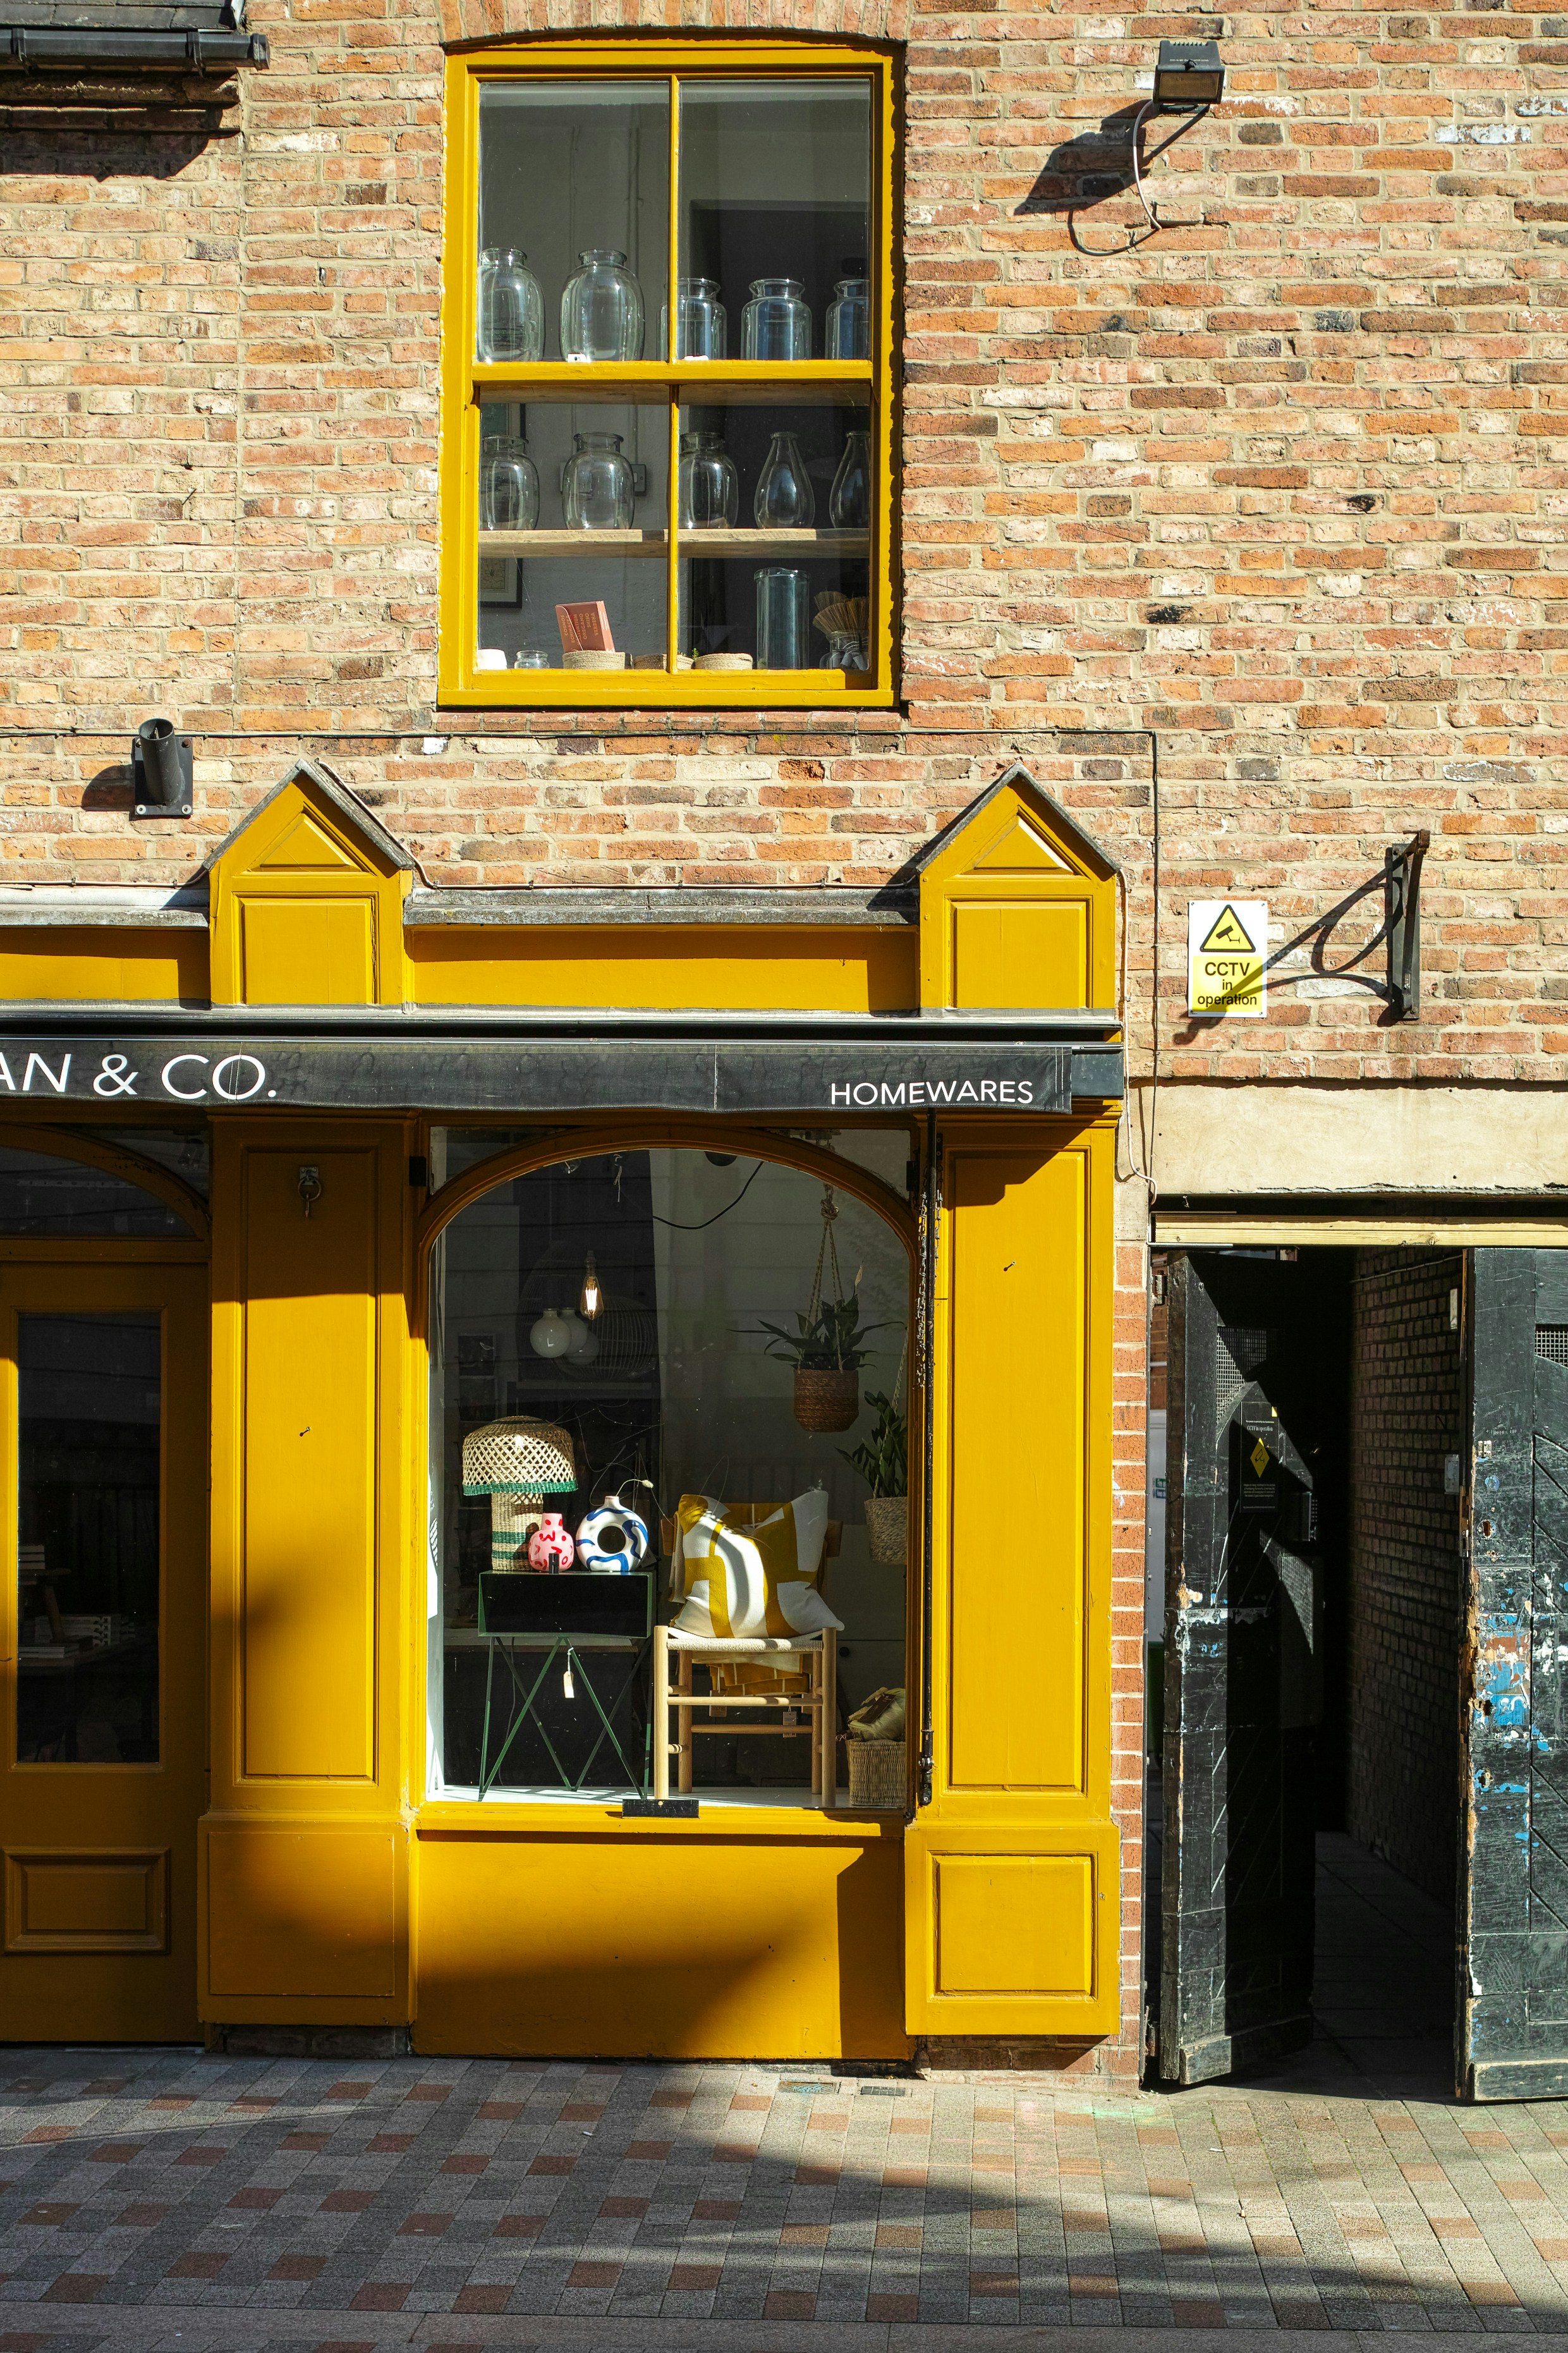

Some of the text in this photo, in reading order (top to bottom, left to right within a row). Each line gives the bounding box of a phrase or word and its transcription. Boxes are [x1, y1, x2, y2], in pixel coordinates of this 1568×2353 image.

[560, 614, 568, 636] COSMOS
[579, 613, 587, 640] OREGANO
[590, 612, 599, 636] VERBENA
[1205, 962, 1250, 976] CCTV
[1222, 979, 1232, 990] in
[1198, 994, 1257, 1008] operation
[93, 1054, 138, 1096] &
[161, 1054, 277, 1100] CO.
[830, 1080, 1033, 1106] HOMEWARES
